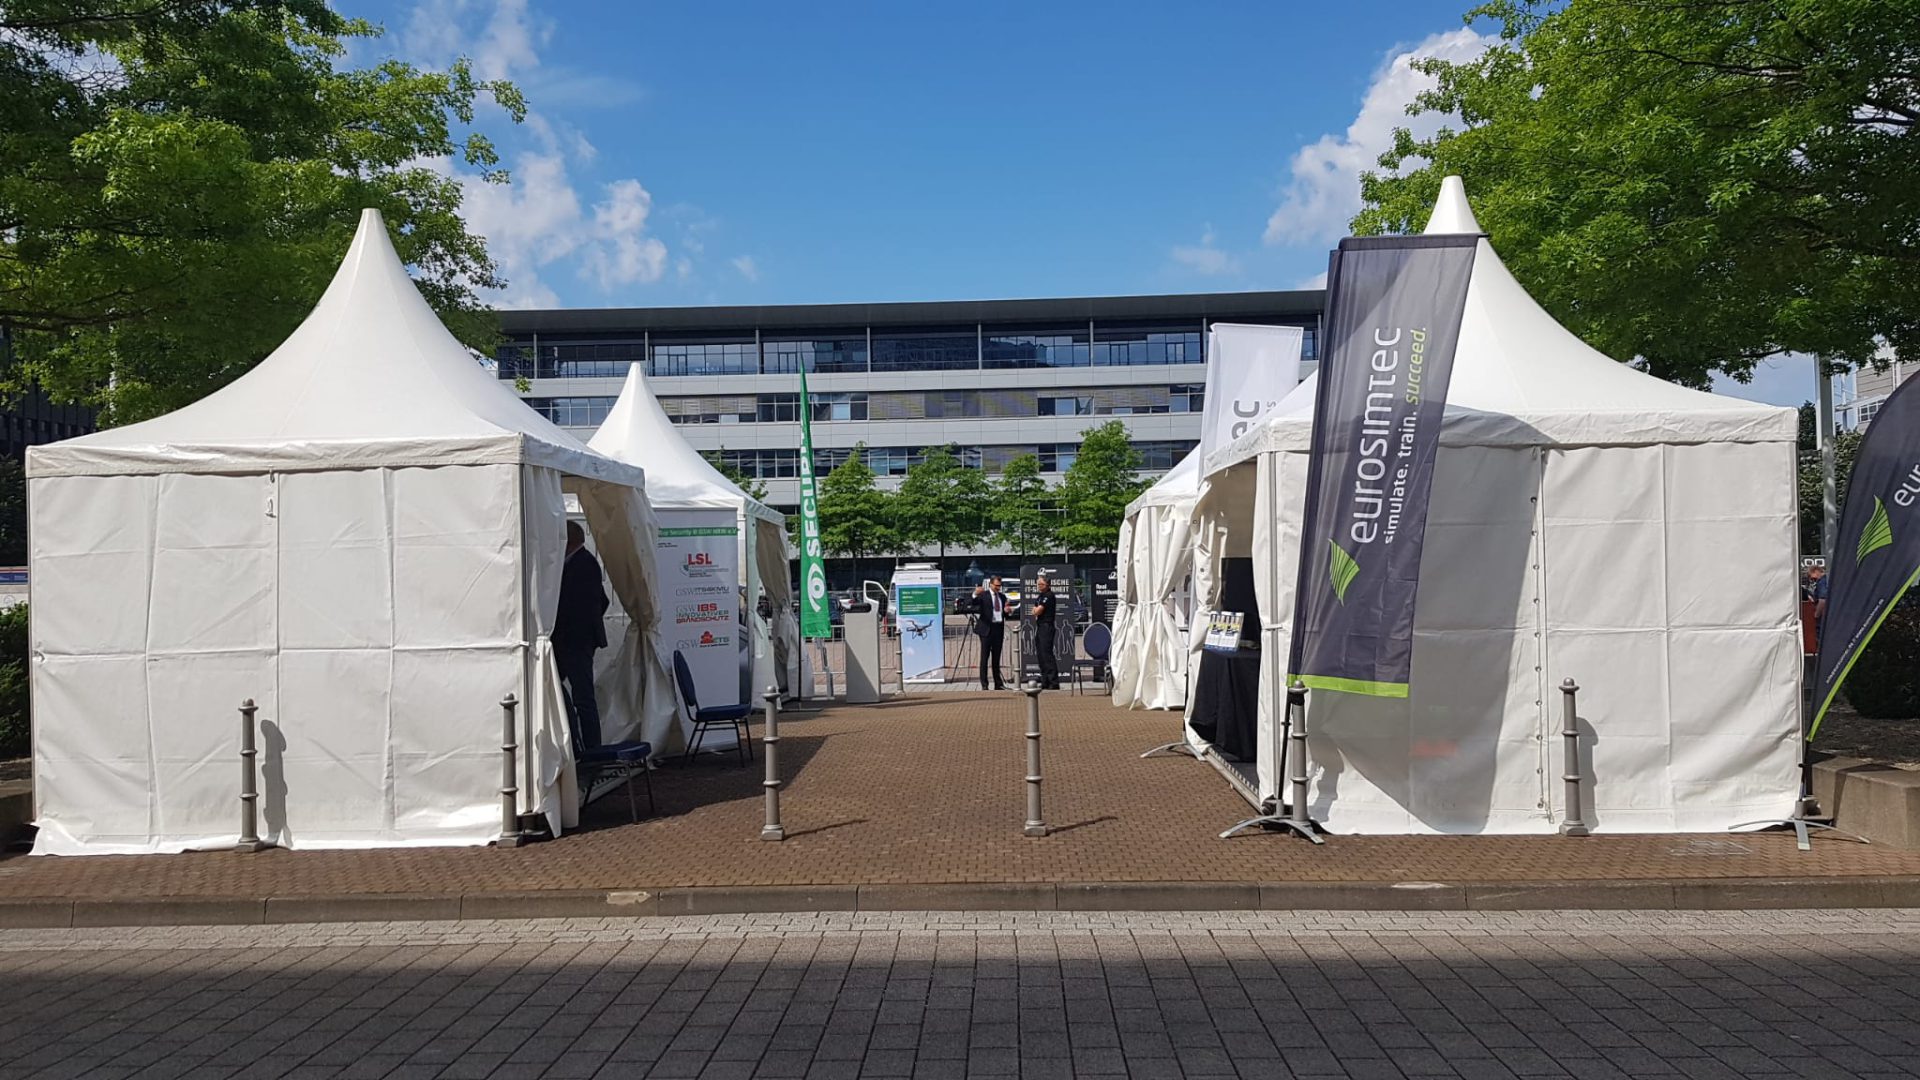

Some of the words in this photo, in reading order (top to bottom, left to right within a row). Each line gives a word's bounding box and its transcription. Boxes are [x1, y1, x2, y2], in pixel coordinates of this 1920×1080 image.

[1405, 327, 1426, 405] succeed.
[1397, 411, 1417, 458] train.
[1383, 463, 1409, 544] simulate.
[688, 553, 712, 565] LSL
[697, 603, 717, 612] IBS
[676, 640, 698, 649] GSW
